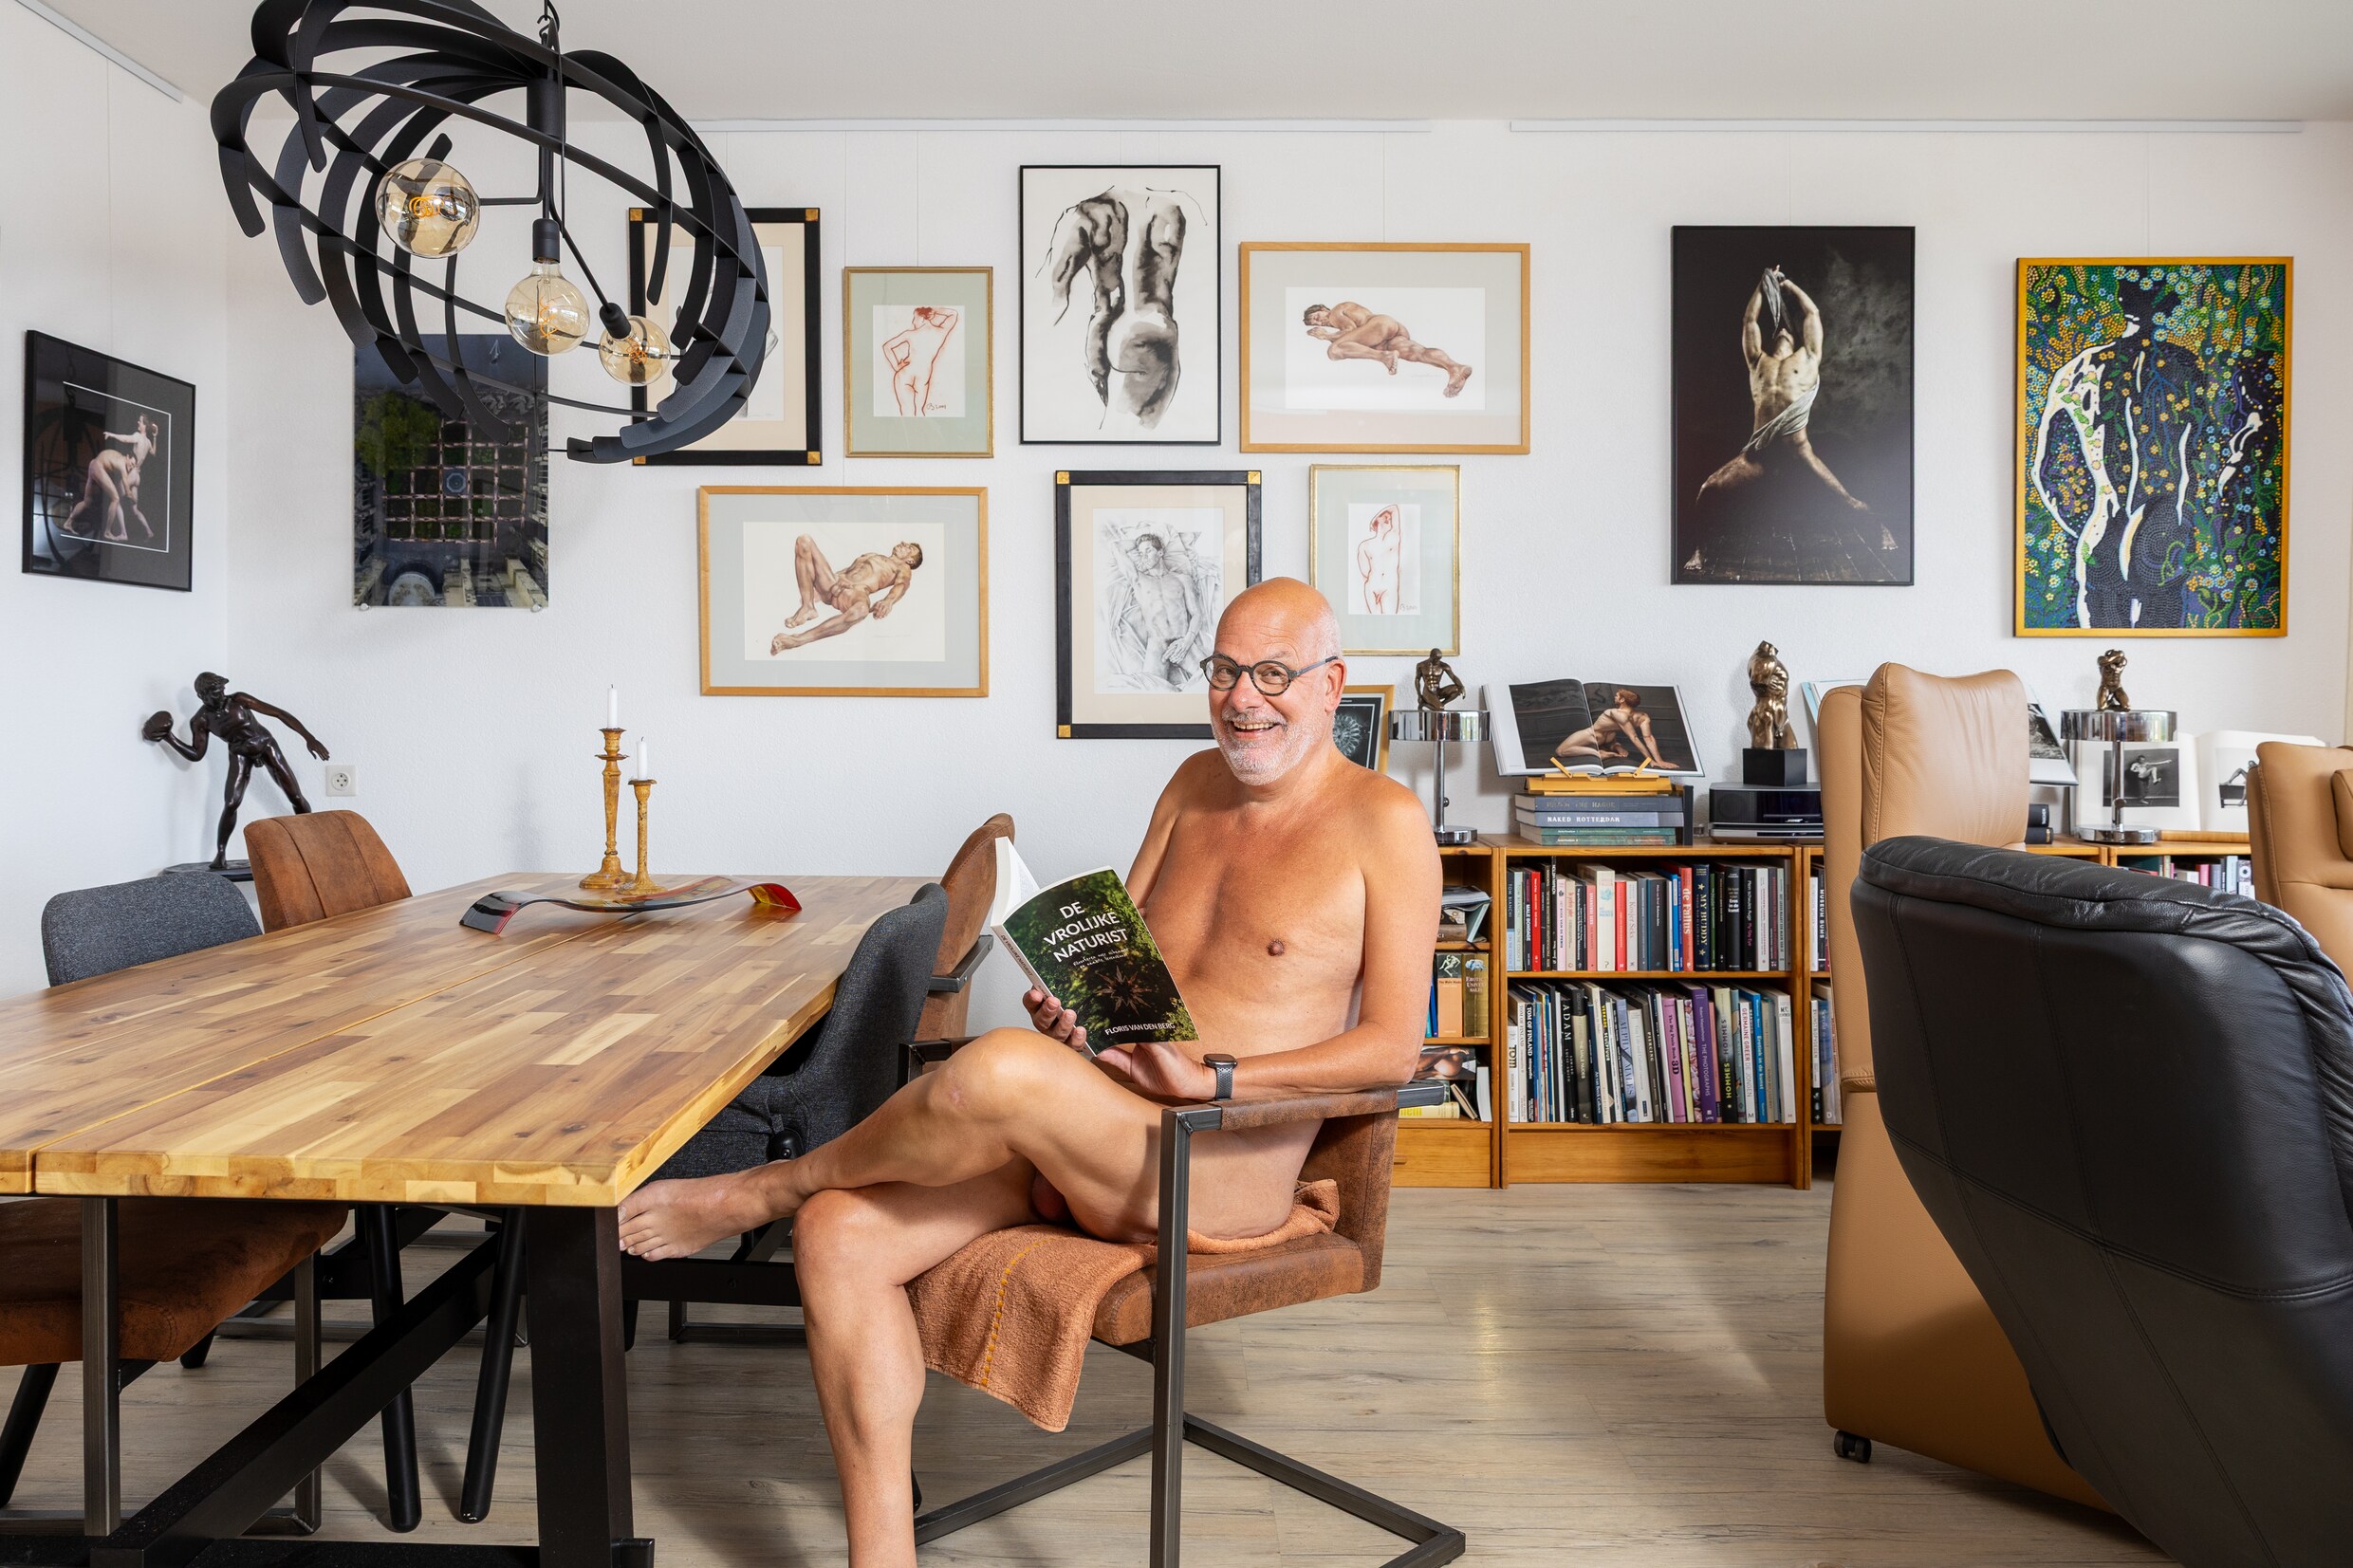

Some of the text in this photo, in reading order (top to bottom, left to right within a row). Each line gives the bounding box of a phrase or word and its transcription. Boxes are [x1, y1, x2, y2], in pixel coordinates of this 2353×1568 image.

[1060, 902, 1085, 919] DE
[1683, 888, 1692, 934] de Fallus
[1701, 894, 1707, 909] MY
[1043, 912, 1119, 945] VROLIJKE
[1053, 929, 1128, 962] NATURIST
[1105, 1025, 1129, 1035] FLORIS
[1563, 1004, 1571, 1040] ADAM
[1671, 1061, 1679, 1074] 3D
